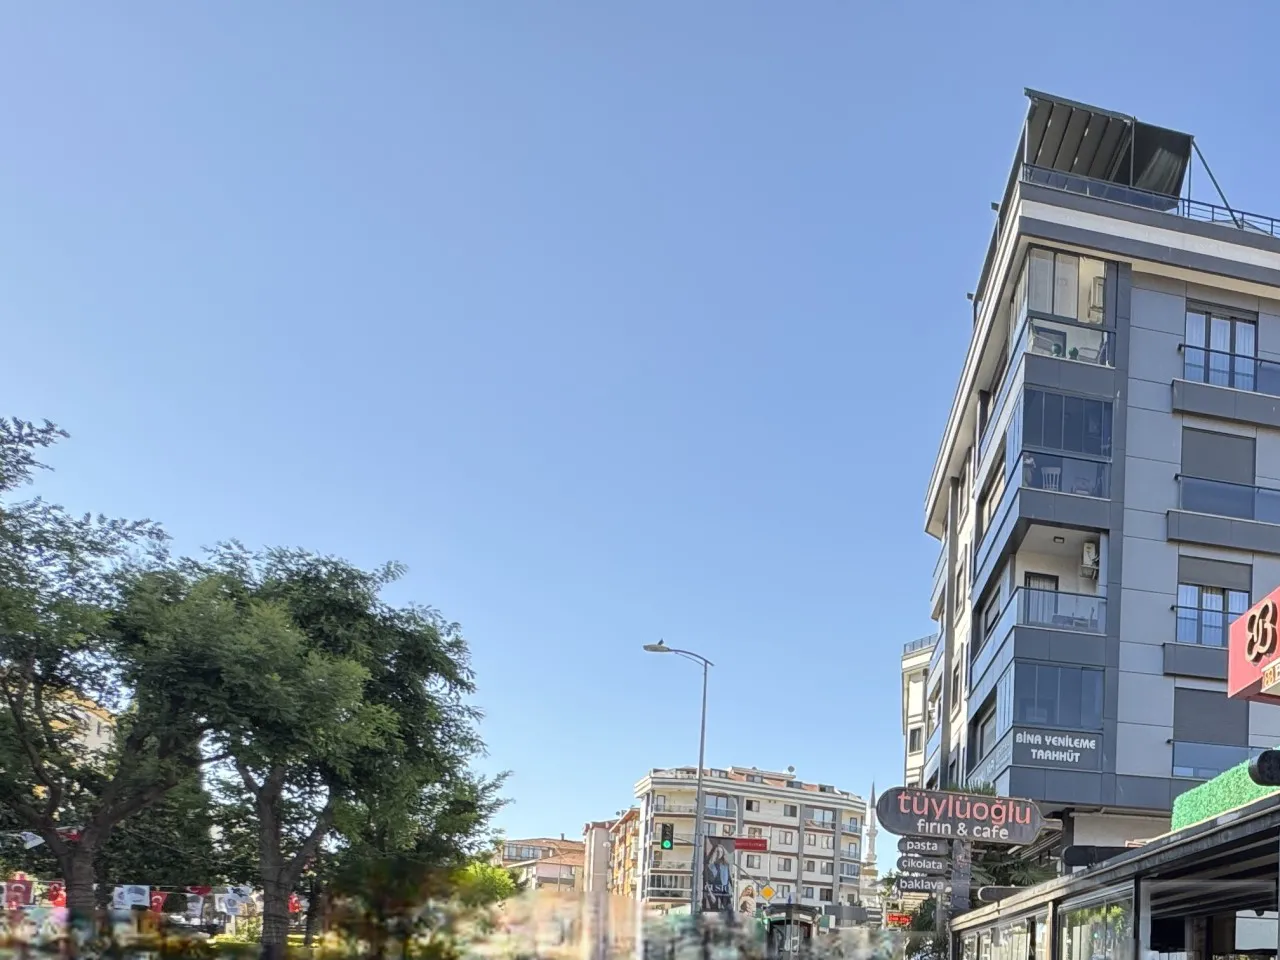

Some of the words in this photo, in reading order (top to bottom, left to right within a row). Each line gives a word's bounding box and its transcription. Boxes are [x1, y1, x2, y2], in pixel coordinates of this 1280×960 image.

[1015, 731, 1042, 744] BİNA
[1044, 734, 1096, 749] YENİLEME
[897, 791, 1031, 825] tüylüoğlu
[956, 822, 967, 836] &
[973, 825, 1009, 839] cafe
[906, 841, 938, 851] pasta
[902, 859, 943, 869] çikolata
[900, 879, 944, 890] baklava
